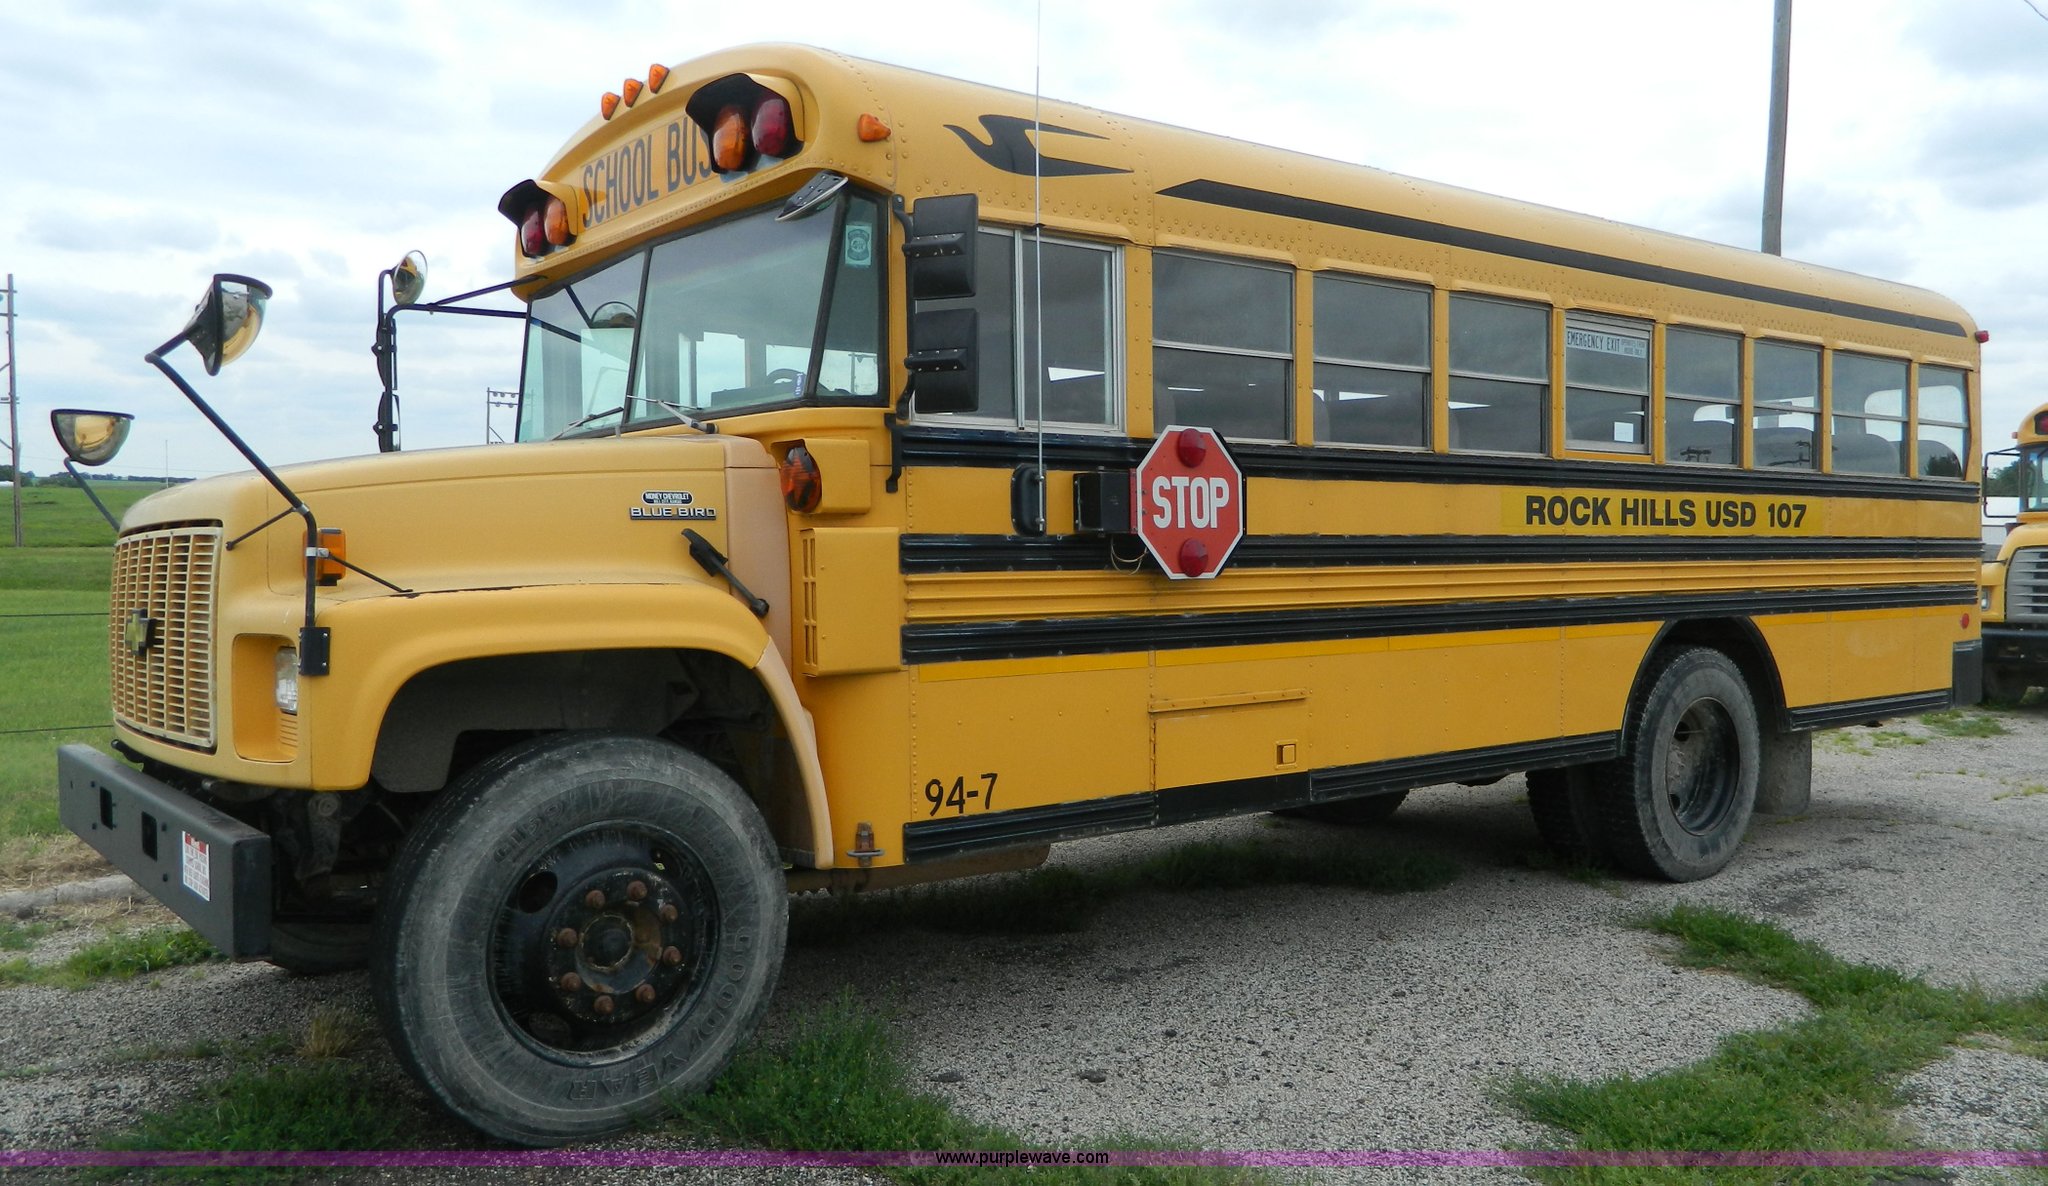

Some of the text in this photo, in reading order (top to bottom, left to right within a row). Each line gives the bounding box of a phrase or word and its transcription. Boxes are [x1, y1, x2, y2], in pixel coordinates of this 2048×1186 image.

[581, 116, 712, 228] SCHOOL BUS
[1567, 331, 1604, 350] EMERGENCY
[1606, 337, 1620, 352] EXIT
[630, 507, 716, 517] BLUE BIRD
[1152, 475, 1230, 528] STOP
[1526, 495, 1807, 528] ROCK HILLS USD 107
[925, 773, 998, 816] 94-7
[569, 925, 753, 1101] GOODYEAR
